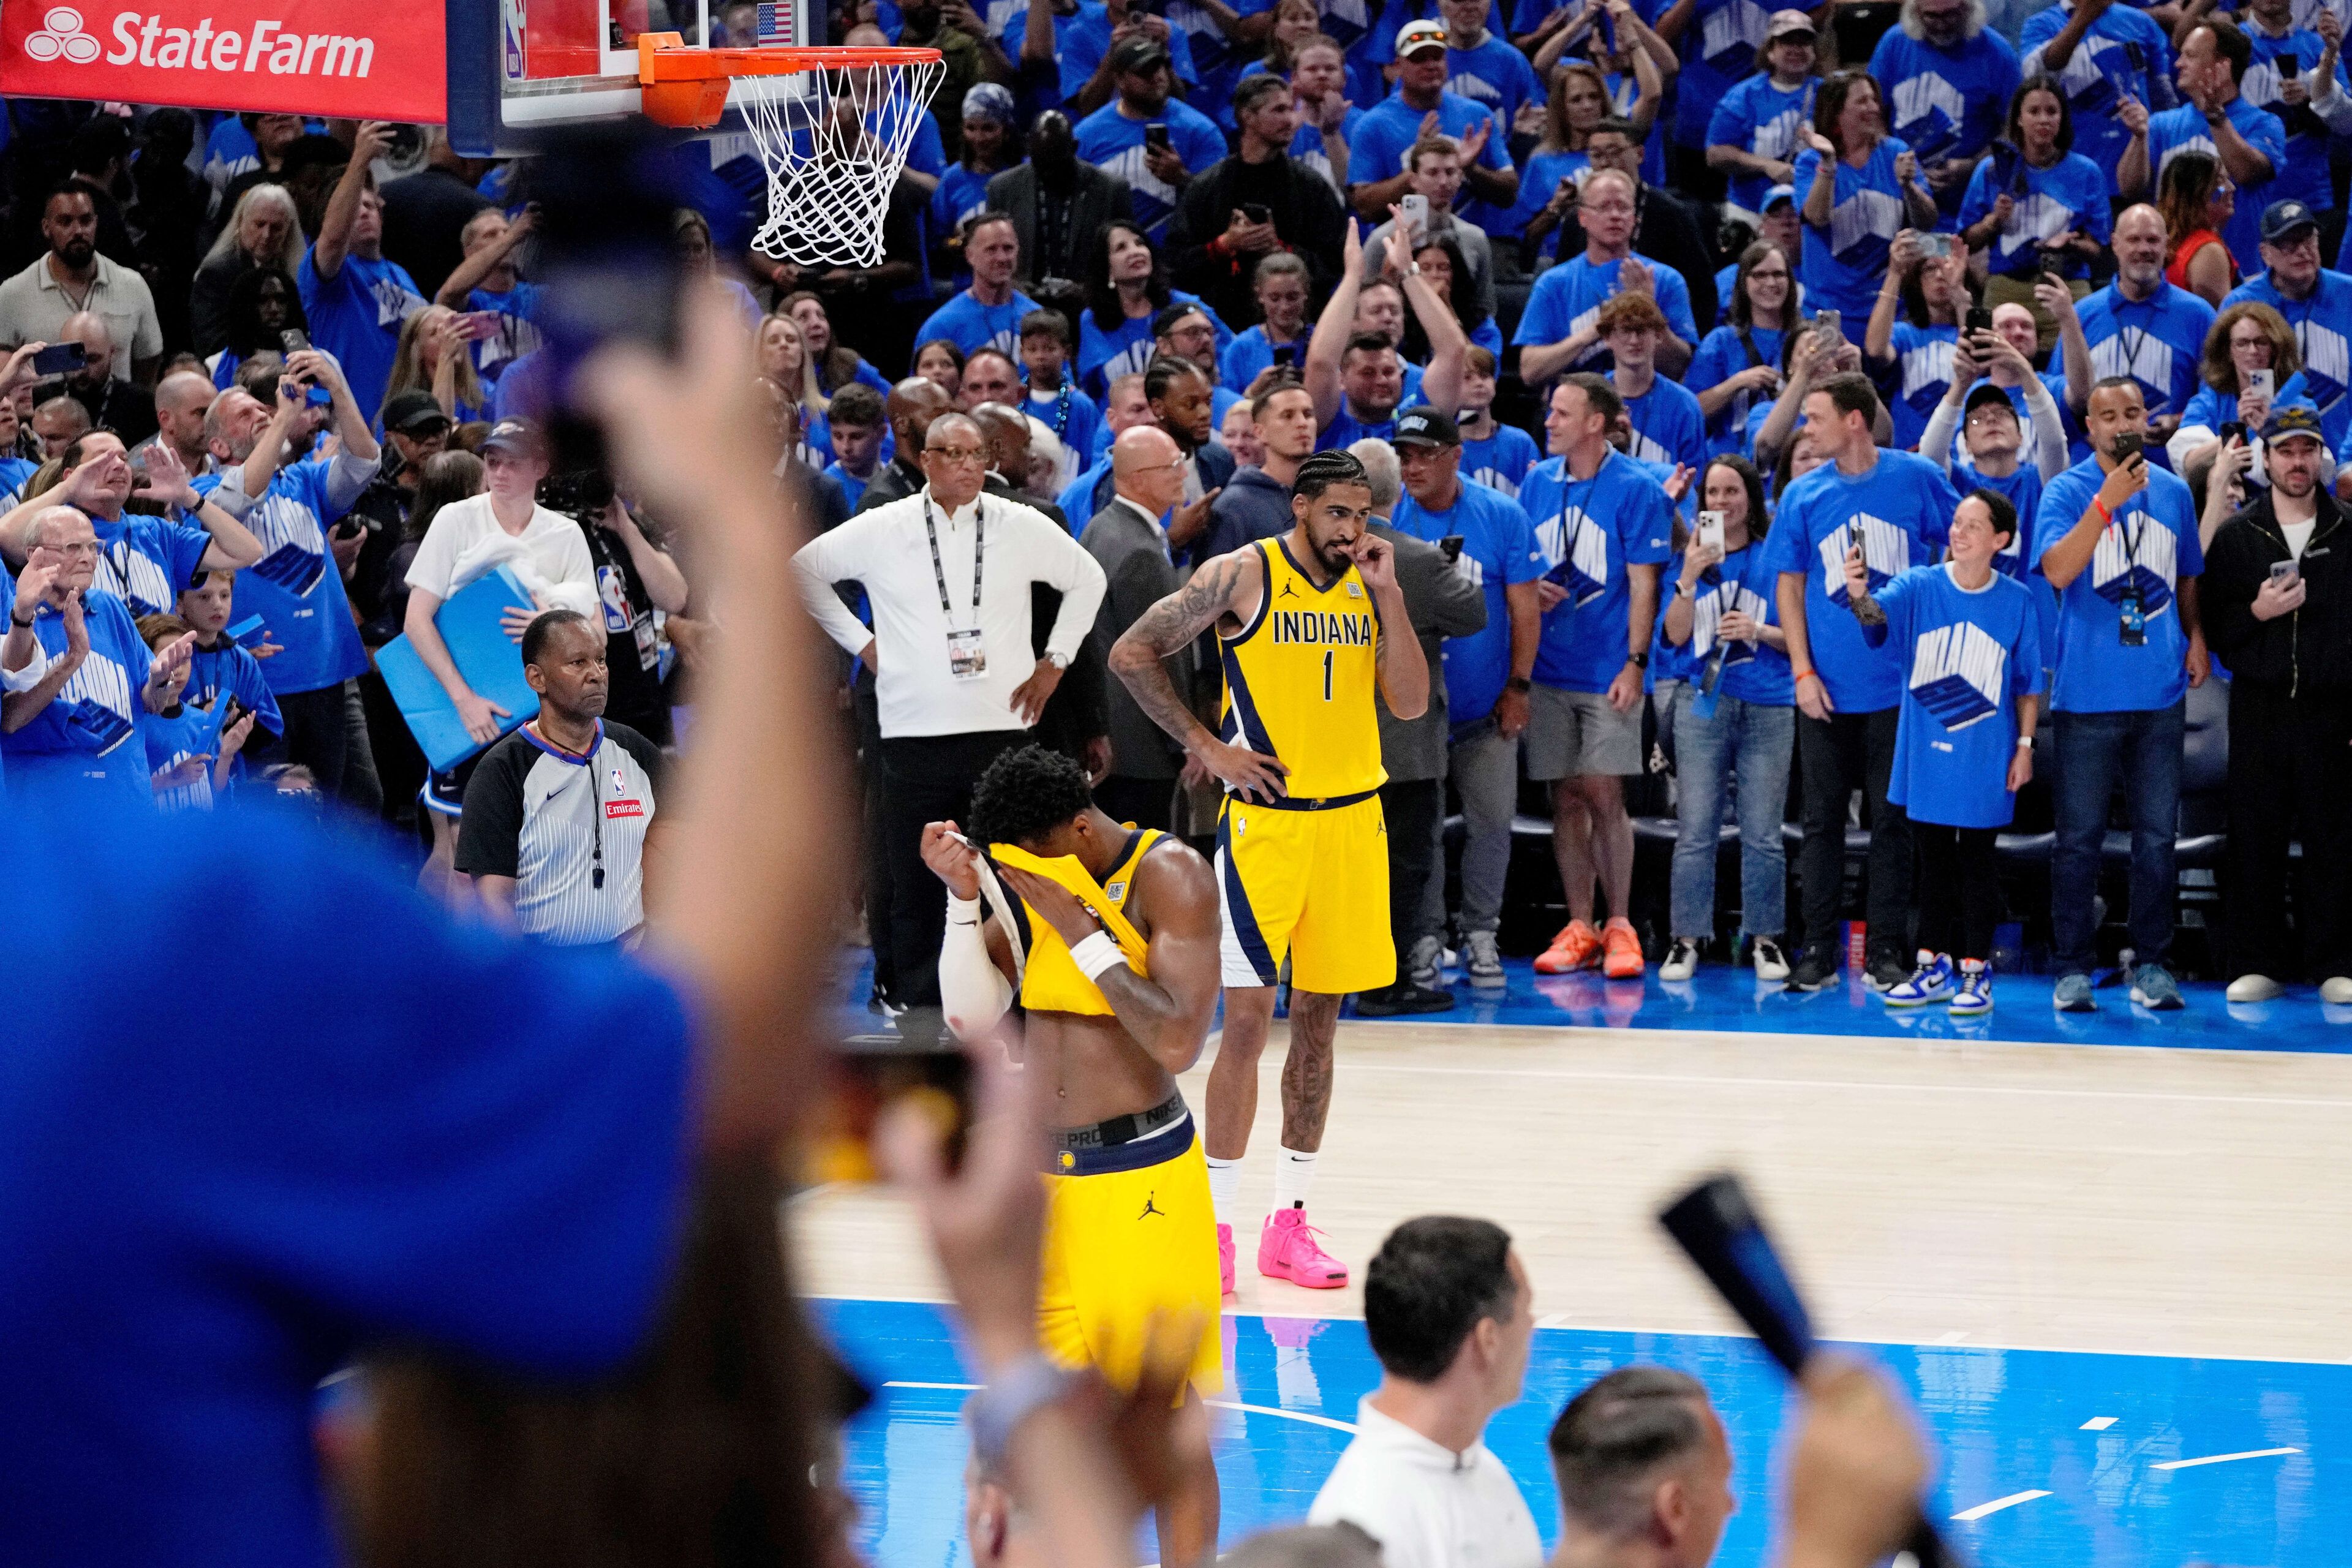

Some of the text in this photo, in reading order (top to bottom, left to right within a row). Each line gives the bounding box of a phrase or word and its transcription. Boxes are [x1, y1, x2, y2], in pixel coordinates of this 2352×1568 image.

[1273, 610, 1371, 647] INDIANA
[1322, 649, 1334, 702] 1
[606, 803, 642, 815] Emirates
[1067, 1127, 1104, 1146] PRO
